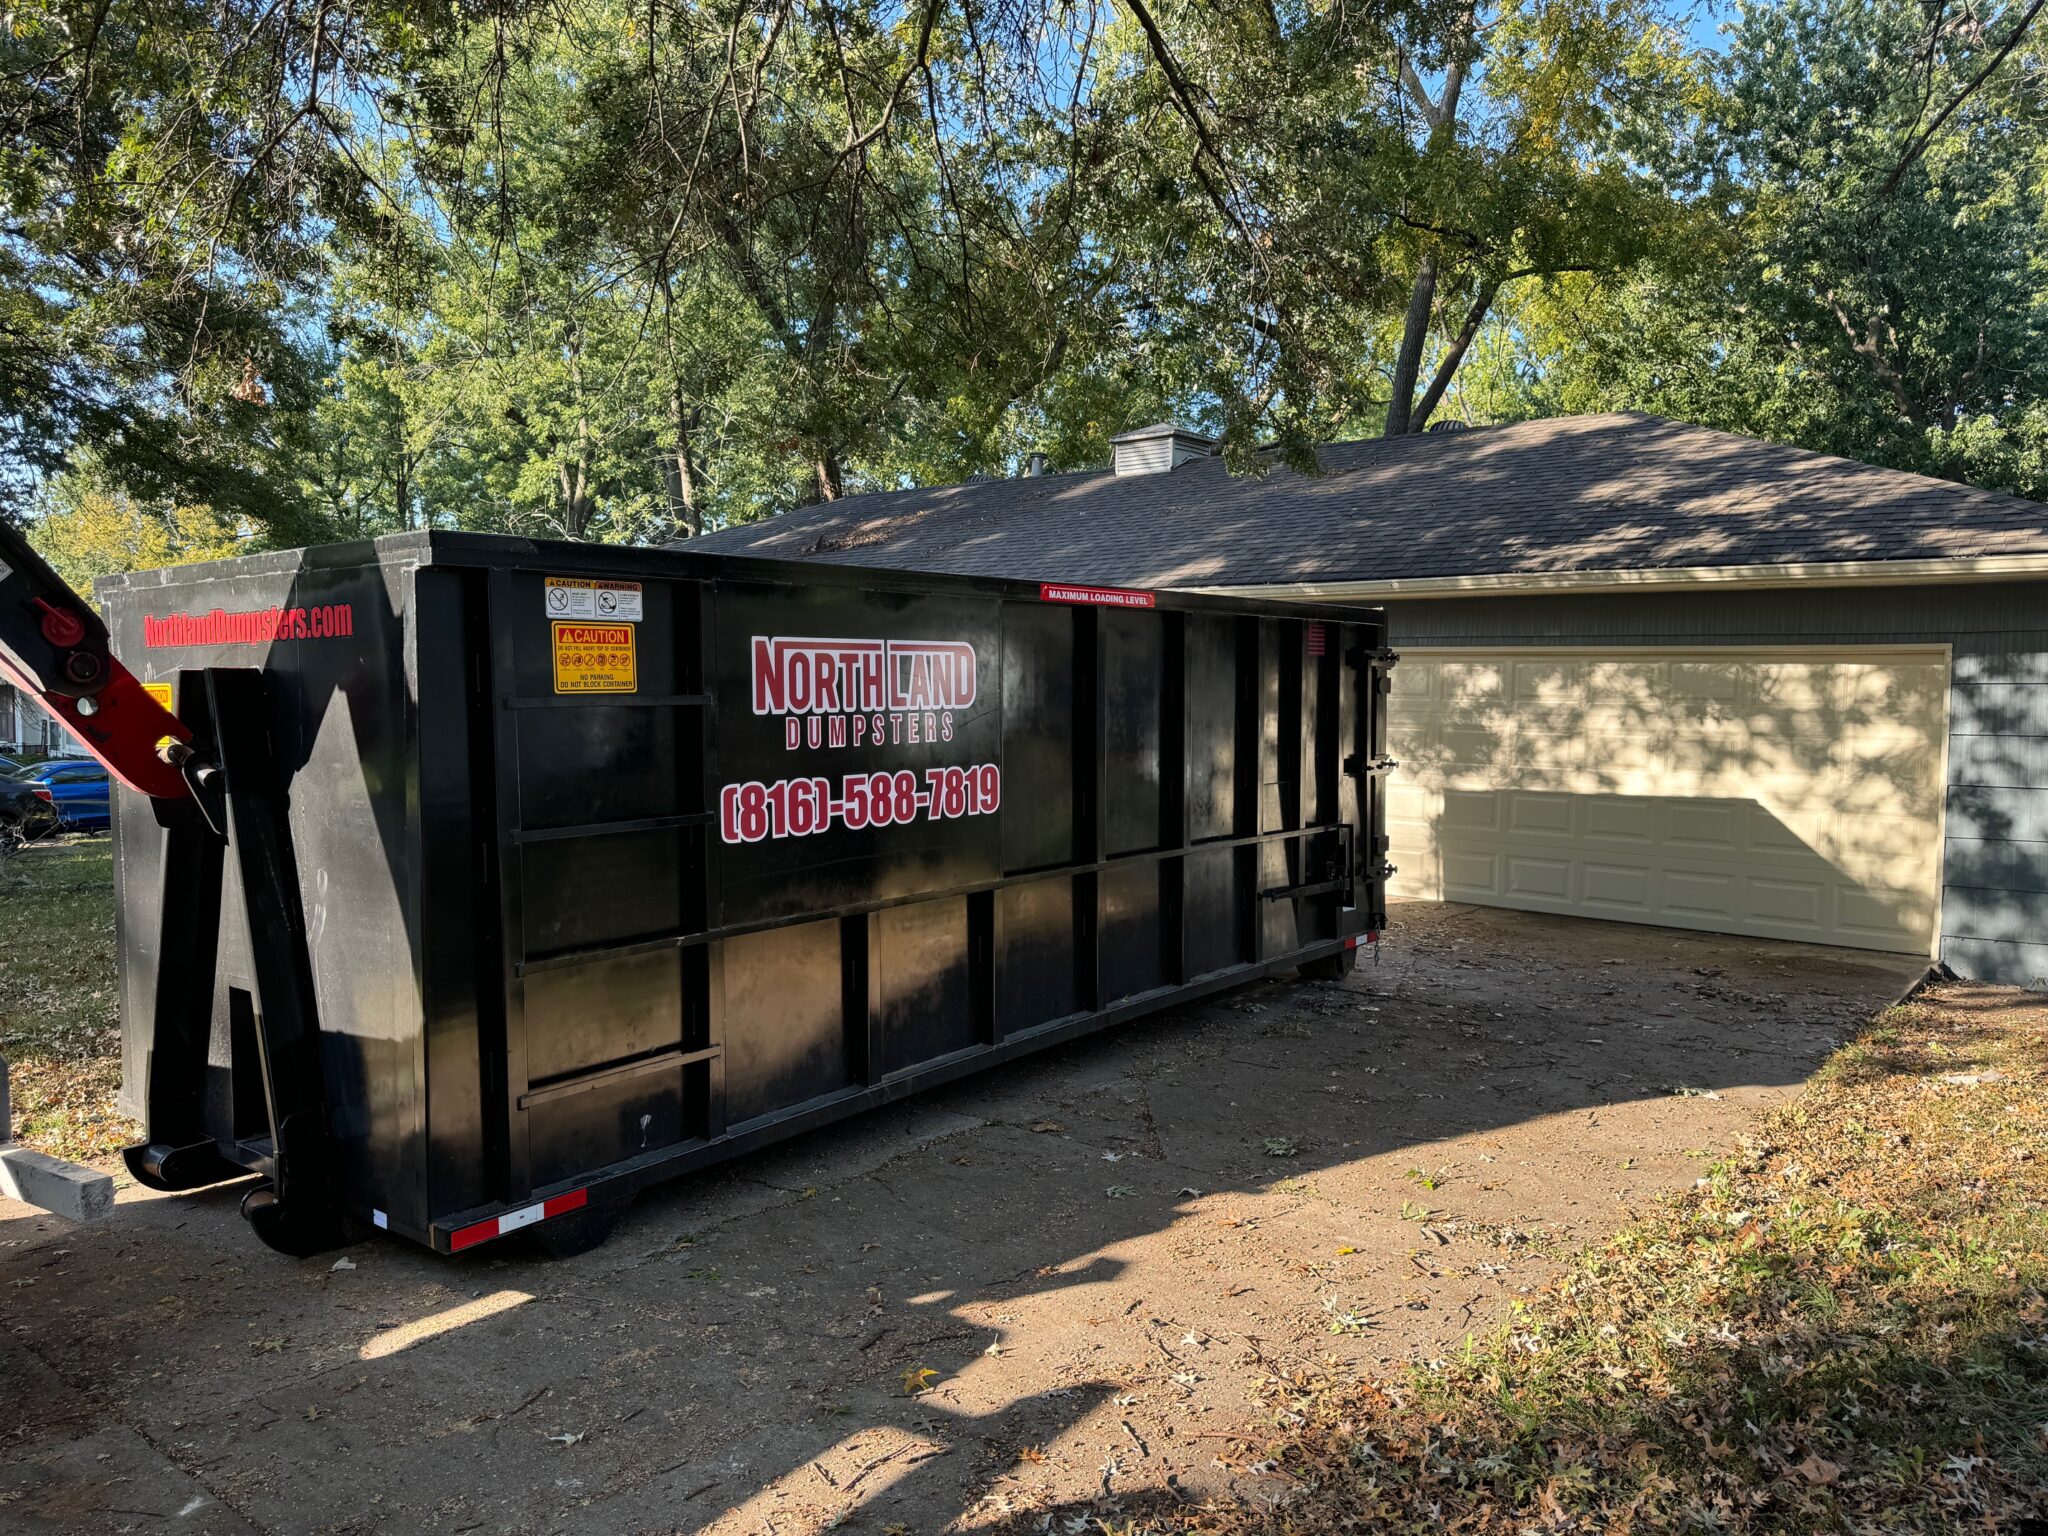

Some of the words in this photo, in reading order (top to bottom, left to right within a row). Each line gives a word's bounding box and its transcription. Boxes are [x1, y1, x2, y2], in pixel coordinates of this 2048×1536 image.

[556, 580, 591, 588] CAUTION
[602, 582, 638, 591] WARNING
[1049, 590, 1088, 601] MAXIMUM
[1091, 593, 1124, 604] LOADING
[1126, 596, 1148, 605] LEVEL
[144, 604, 352, 648] NorthlandDumpsters.com
[574, 629, 625, 643] CAUTION
[752, 636, 976, 715] NORTHLAND
[786, 712, 953, 750] DUMPSTERS
[721, 764, 1000, 843] (816)-588-7819
